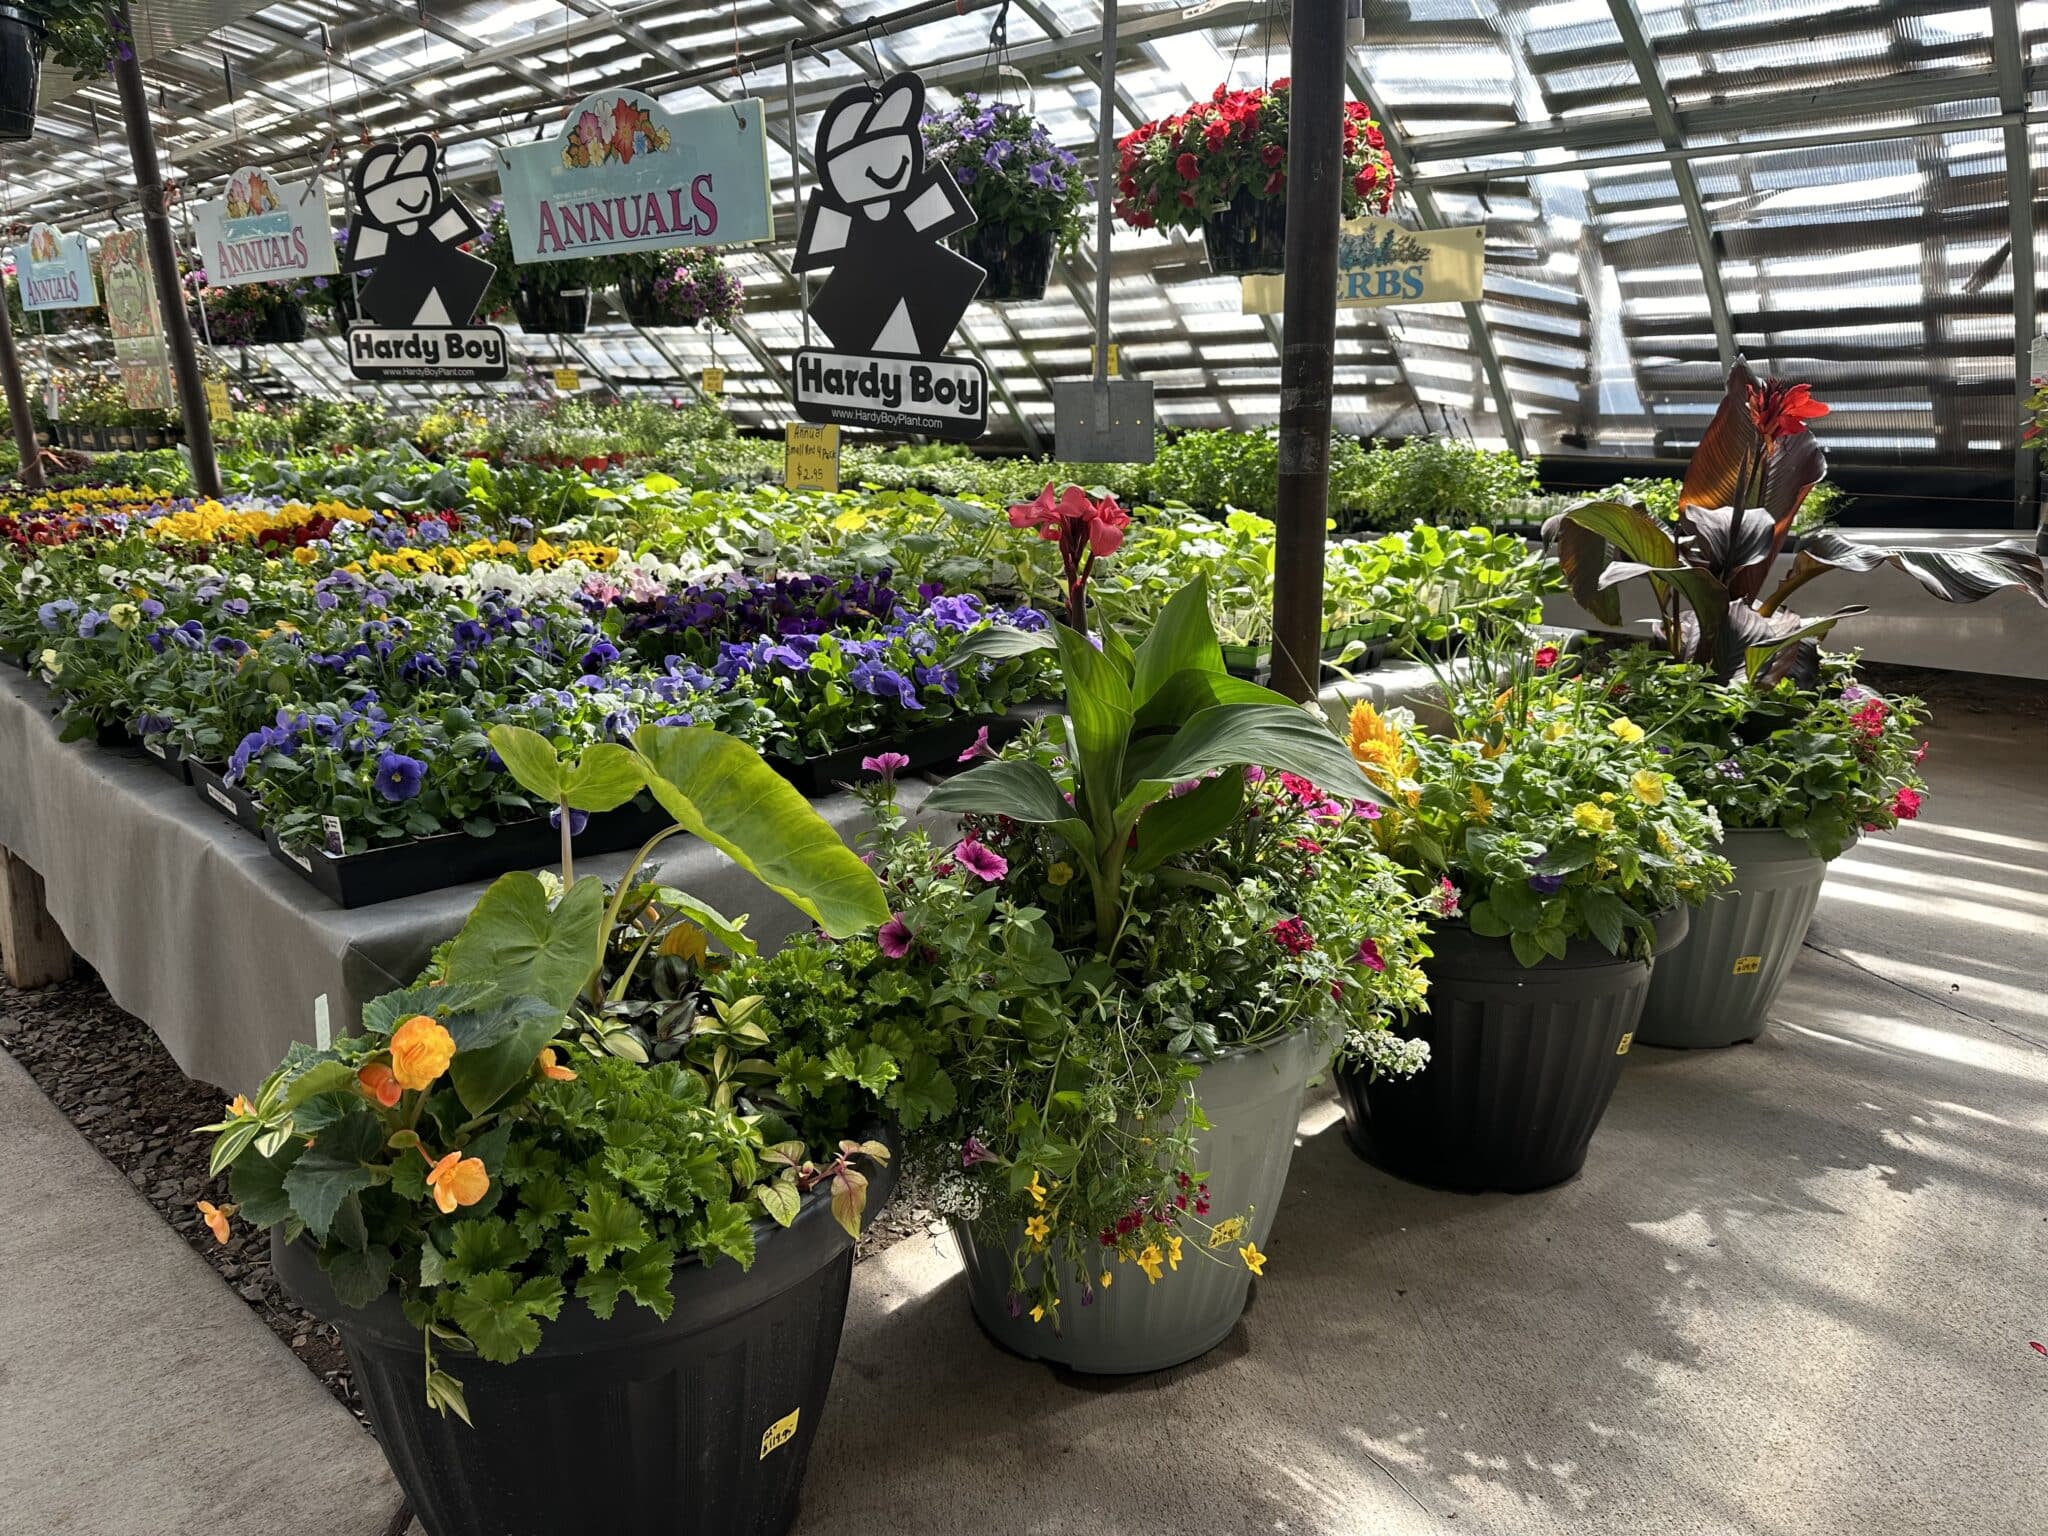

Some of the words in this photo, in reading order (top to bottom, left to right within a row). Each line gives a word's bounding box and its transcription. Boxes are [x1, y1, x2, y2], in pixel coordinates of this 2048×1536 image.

[537, 173, 718, 254] ANNUALS
[217, 226, 309, 279] ANNUALS
[26, 270, 79, 306] ANNUALS
[1336, 265, 1424, 300] RBS
[353, 333, 441, 365] Hardy
[444, 333, 501, 365] Boy
[382, 367, 475, 377] www.HardyBoyPlant.com
[799, 356, 902, 409] Hardy
[909, 365, 979, 415] Boy
[831, 408, 943, 429] www.HardyBoyPlant.com
[797, 462, 824, 482] $2.95
